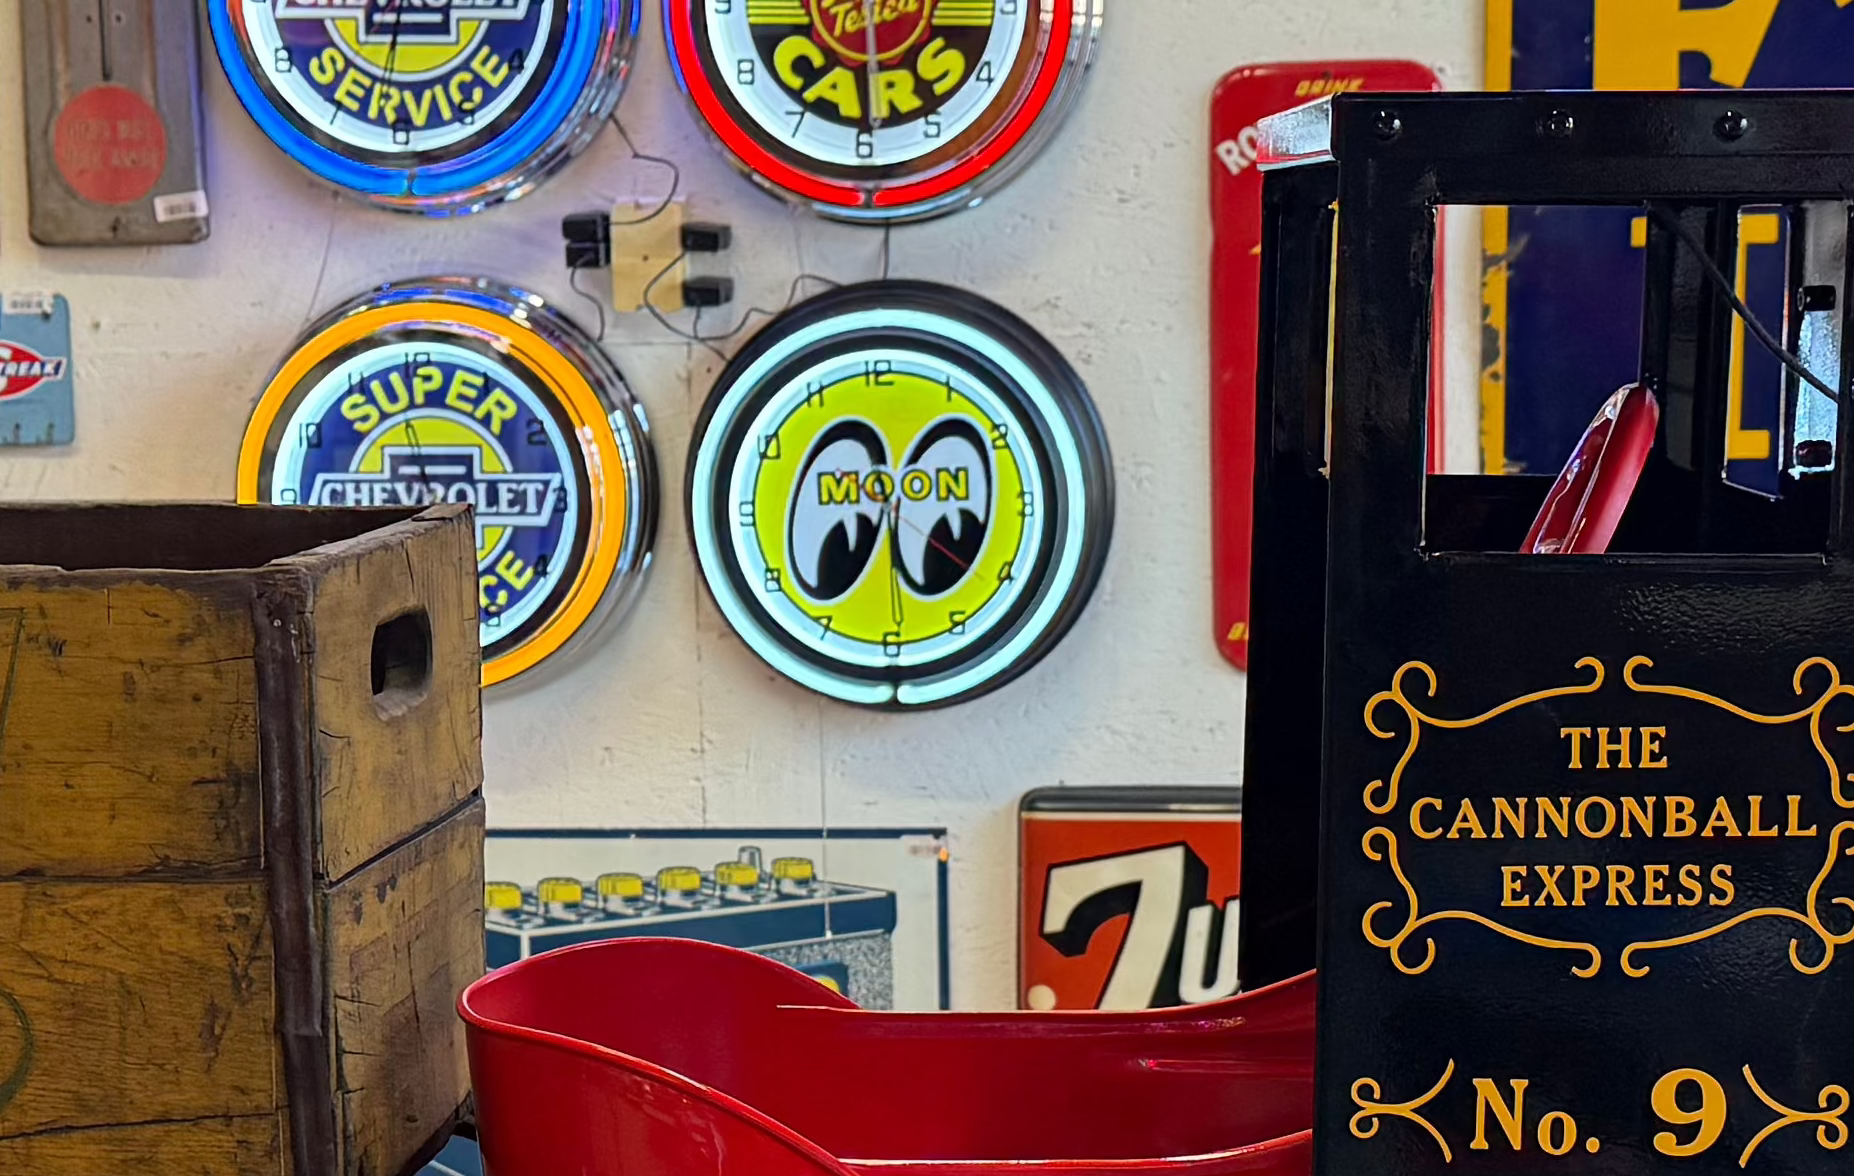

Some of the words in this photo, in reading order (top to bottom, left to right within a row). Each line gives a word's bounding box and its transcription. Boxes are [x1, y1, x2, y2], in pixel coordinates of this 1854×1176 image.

[309, 45, 509, 127] SERVICE
[737, 58, 755, 86] 8
[773, 35, 966, 119] CARS
[976, 60, 994, 87] 4
[1295, 79, 1363, 96] DRINK
[785, 110, 806, 138] 7
[923, 112, 942, 138] 5
[855, 132, 874, 158] 6
[864, 360, 895, 387] 12
[340, 365, 519, 437] SUPER
[527, 419, 548, 446] 2
[321, 482, 543, 514] CHEVROLET
[817, 466, 969, 505] MOON
[1560, 726, 1669, 769] THE
[1409, 795, 1818, 839] CANNONBALL
[1500, 863, 1735, 907] EXPRESS
[1470, 1078, 1600, 1155] No.
[1651, 1067, 1727, 1157] 9
